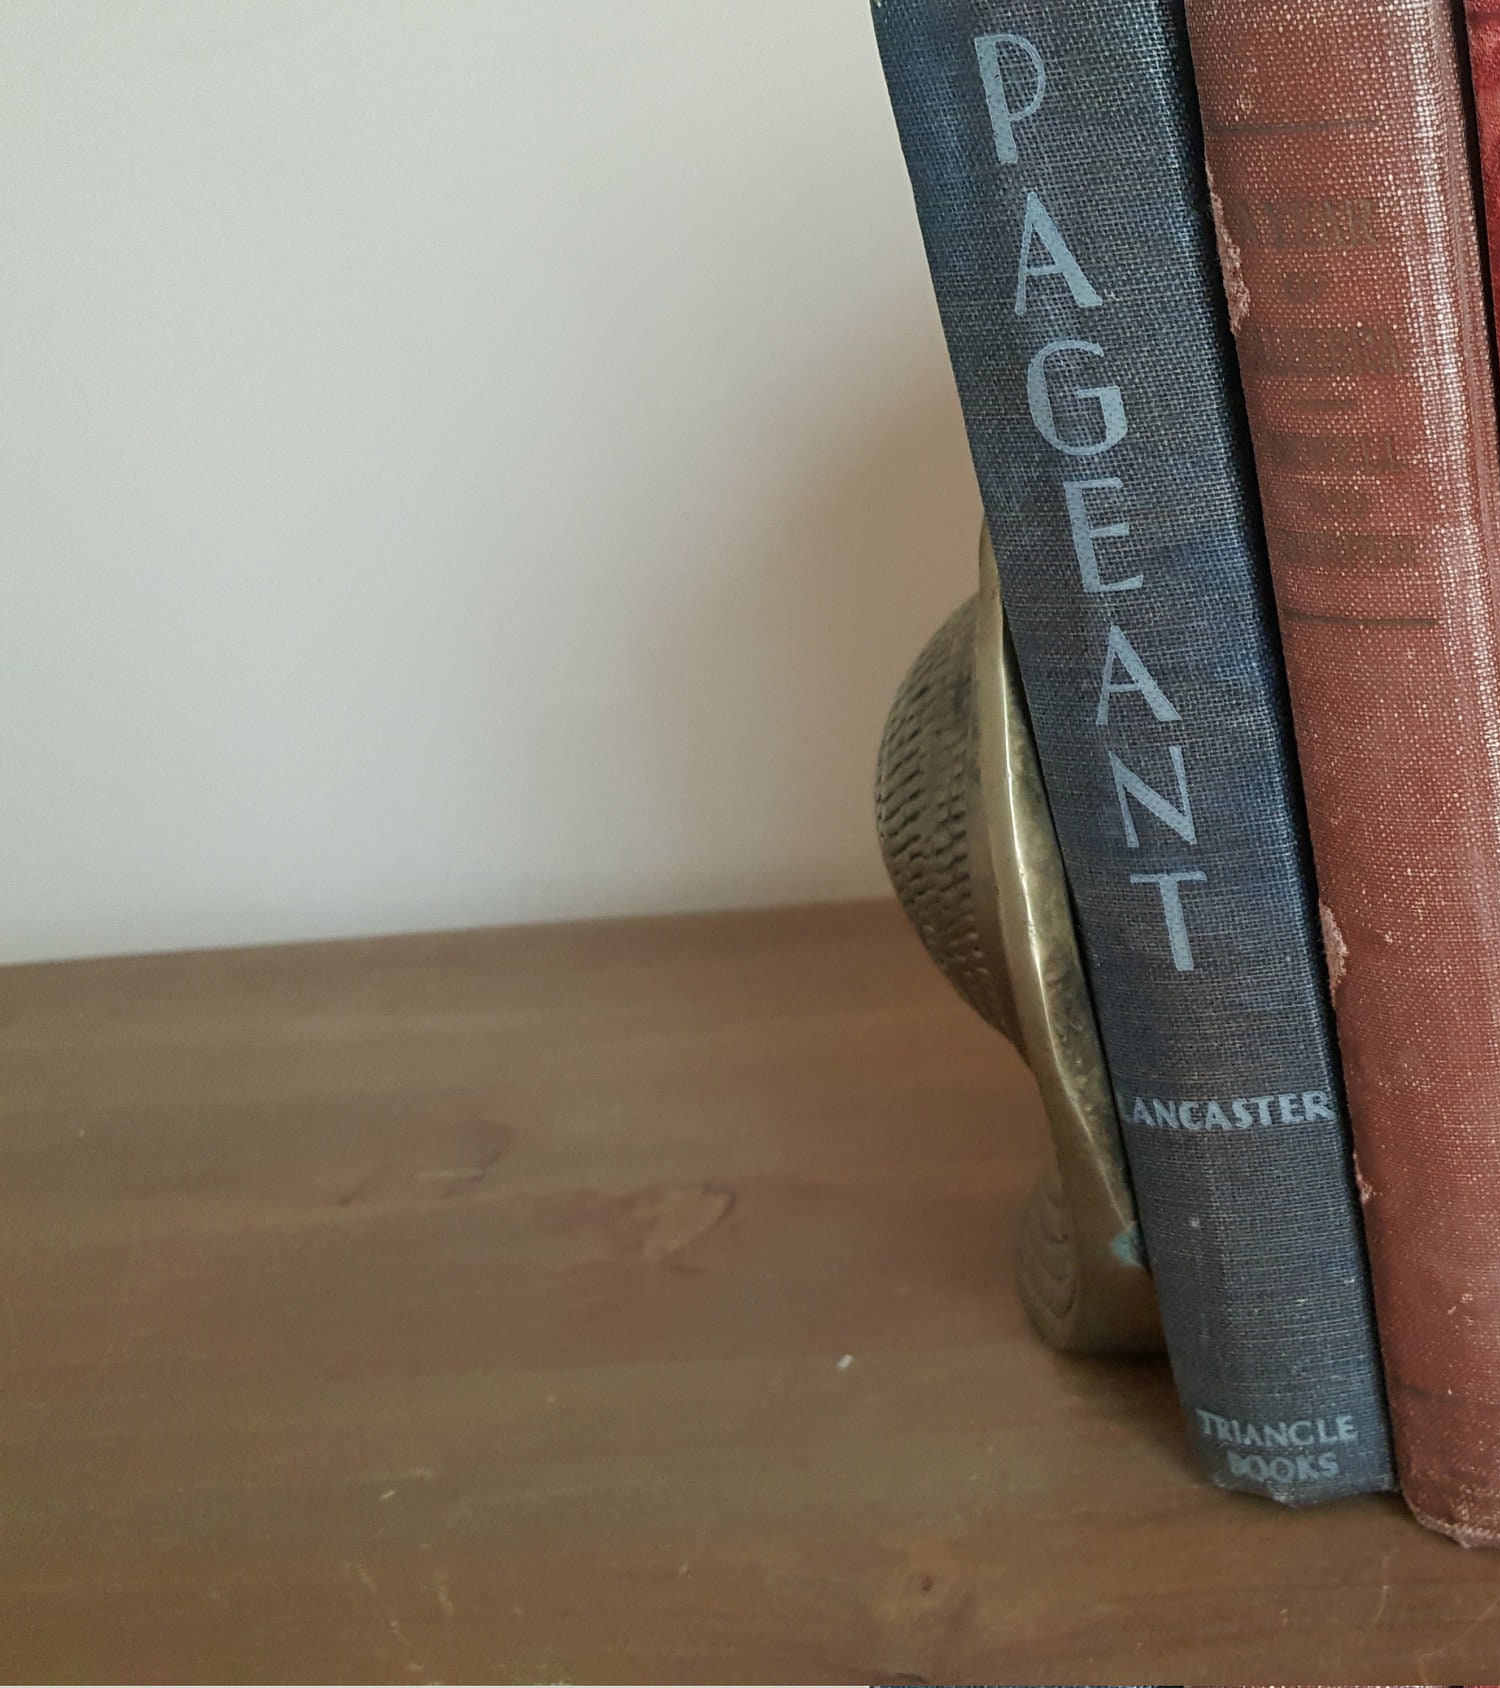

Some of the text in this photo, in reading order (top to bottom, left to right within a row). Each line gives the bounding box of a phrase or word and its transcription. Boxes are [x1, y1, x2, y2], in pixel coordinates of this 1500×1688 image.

[974, 34, 1206, 972] PAGEANT
[1116, 1090, 1337, 1131] LANCASTER
[1196, 1408, 1360, 1448] TRIANGLE
[1226, 1450, 1340, 1484] BOOKS
